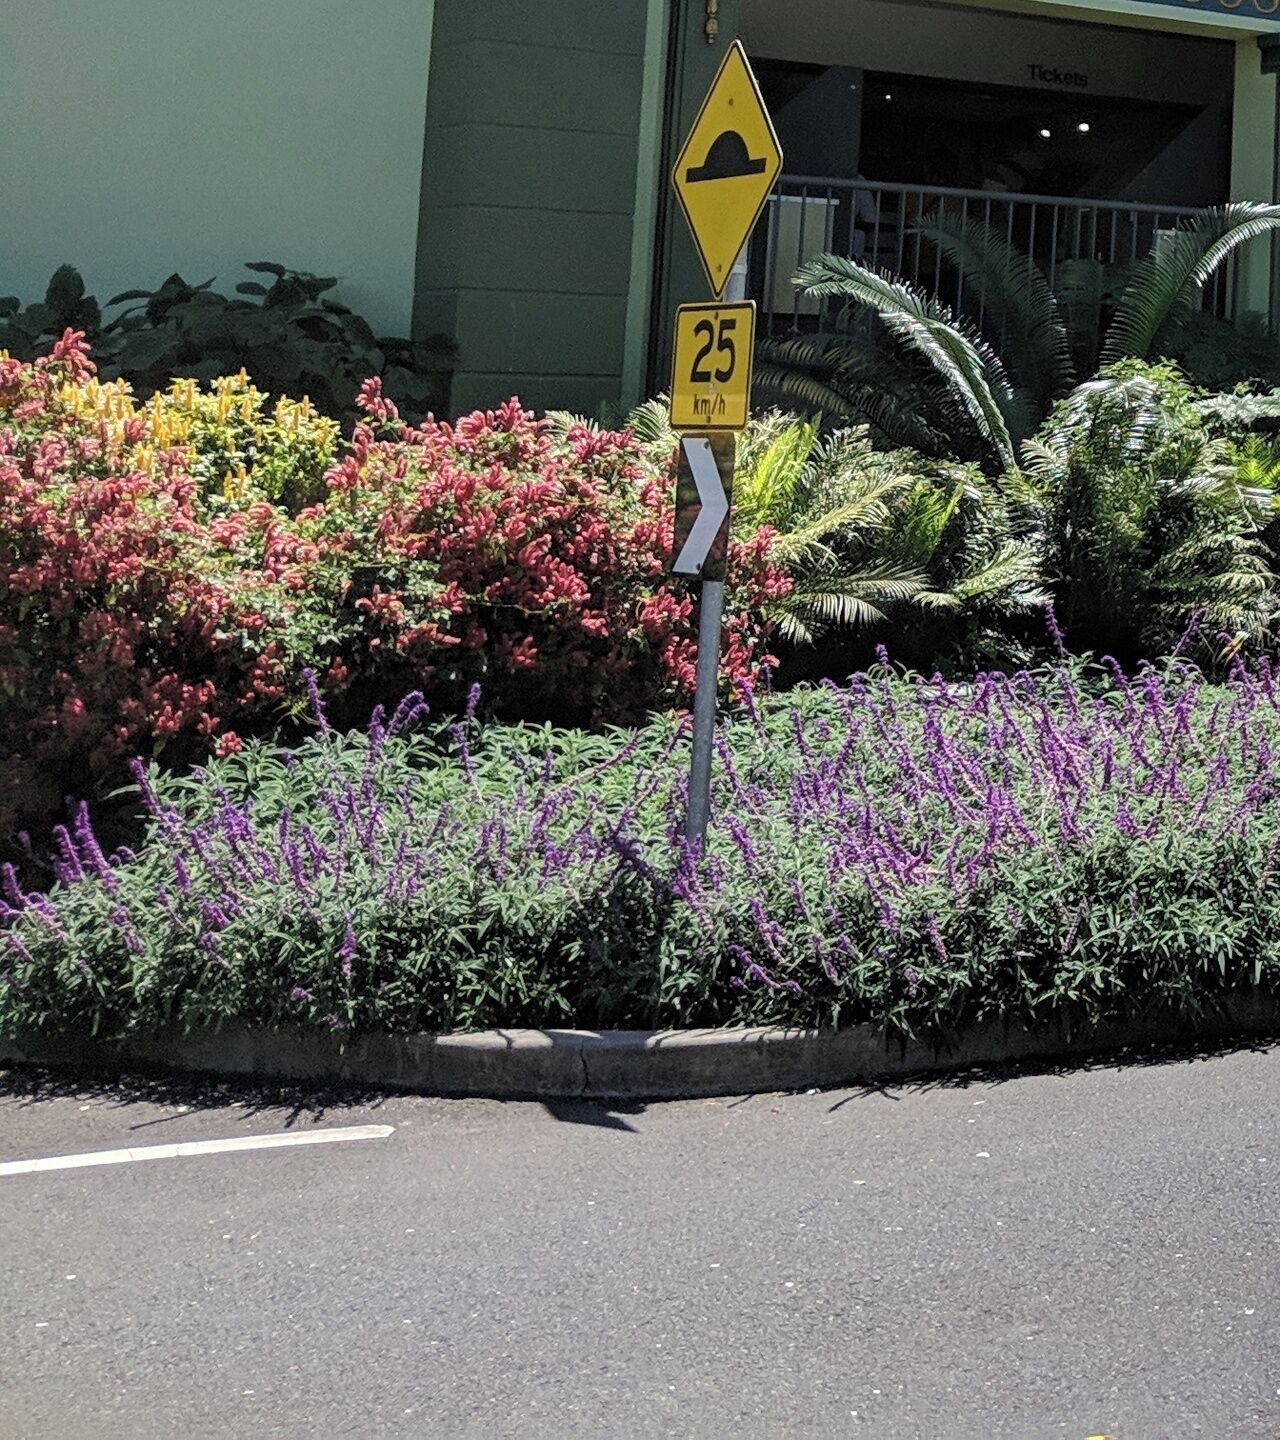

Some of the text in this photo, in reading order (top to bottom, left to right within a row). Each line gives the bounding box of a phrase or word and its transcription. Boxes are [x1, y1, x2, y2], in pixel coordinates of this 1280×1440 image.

[1027, 63, 1089, 89] Tickets
[690, 318, 736, 383] 25
[692, 393, 726, 415] km/h
